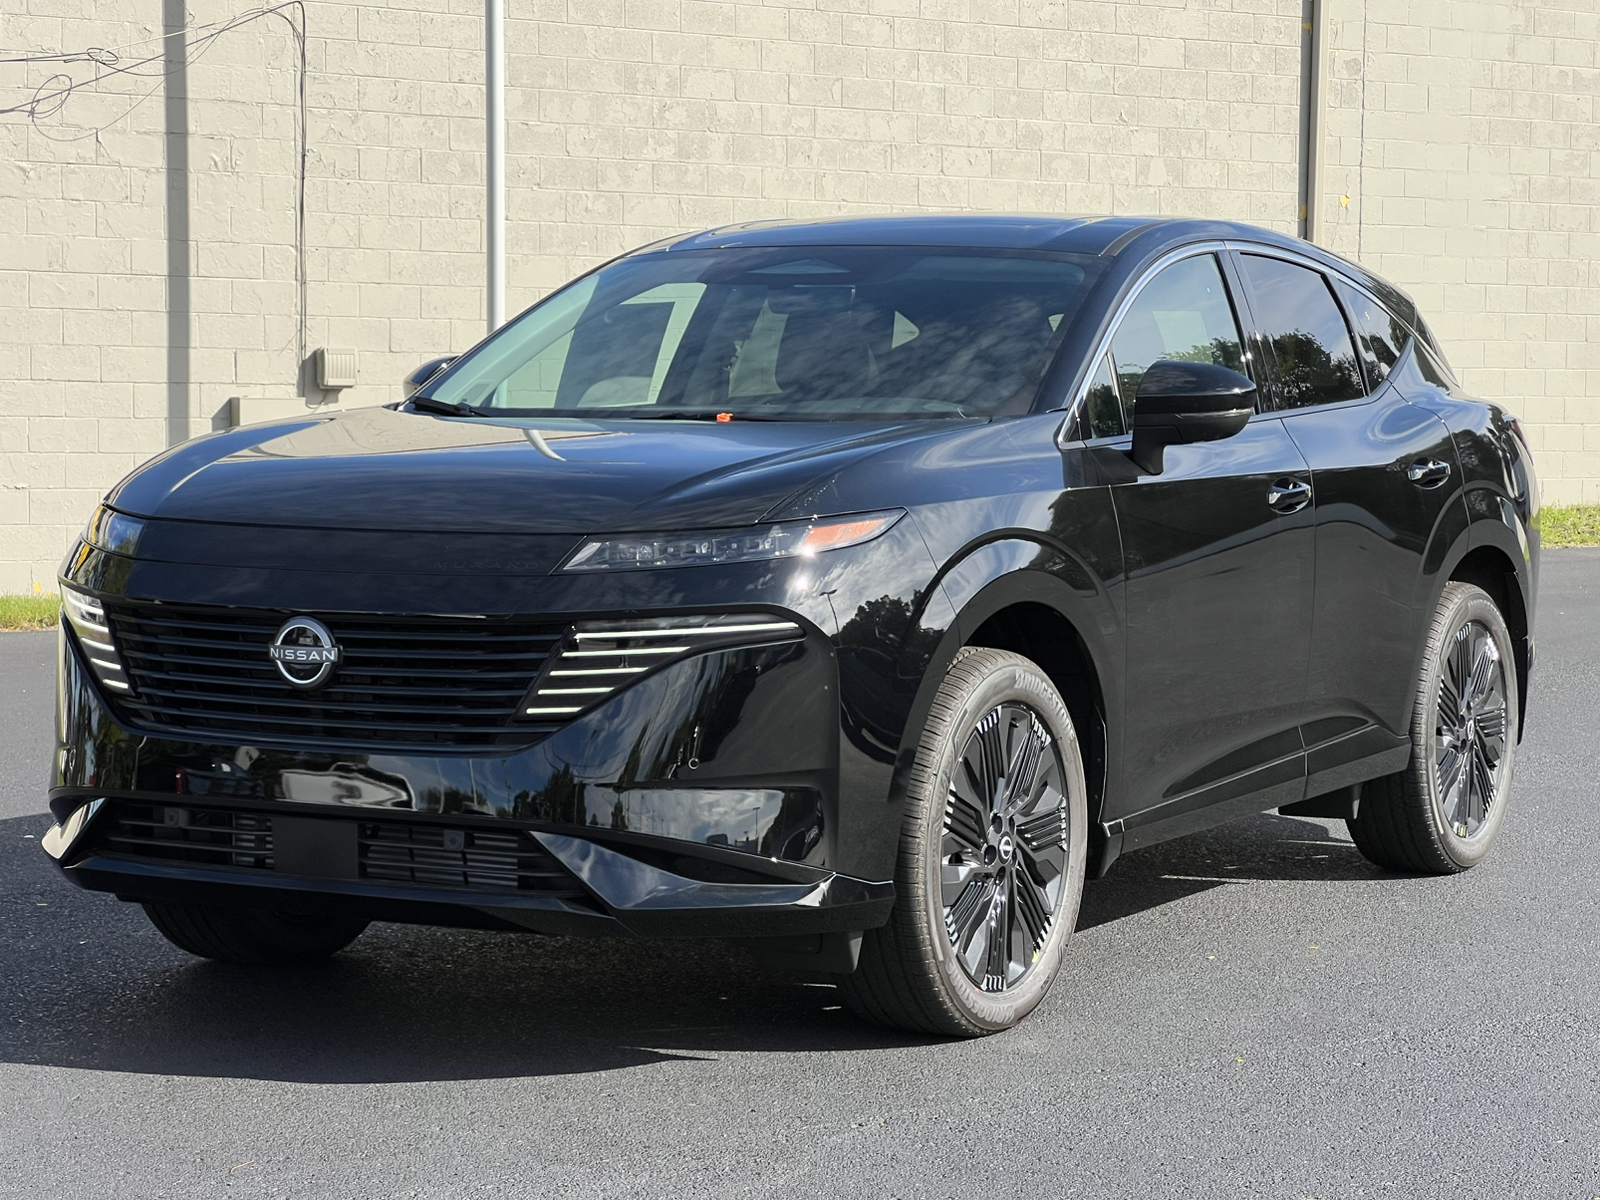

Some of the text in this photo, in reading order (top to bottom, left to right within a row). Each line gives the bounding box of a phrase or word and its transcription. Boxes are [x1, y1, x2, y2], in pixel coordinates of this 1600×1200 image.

[433, 561, 540, 570] MURANO
[270, 647, 335, 661] NISSAN
[1013, 669, 1076, 741] BRIDGESTONE
[945, 958, 1016, 1025] BRIDGESTONE
